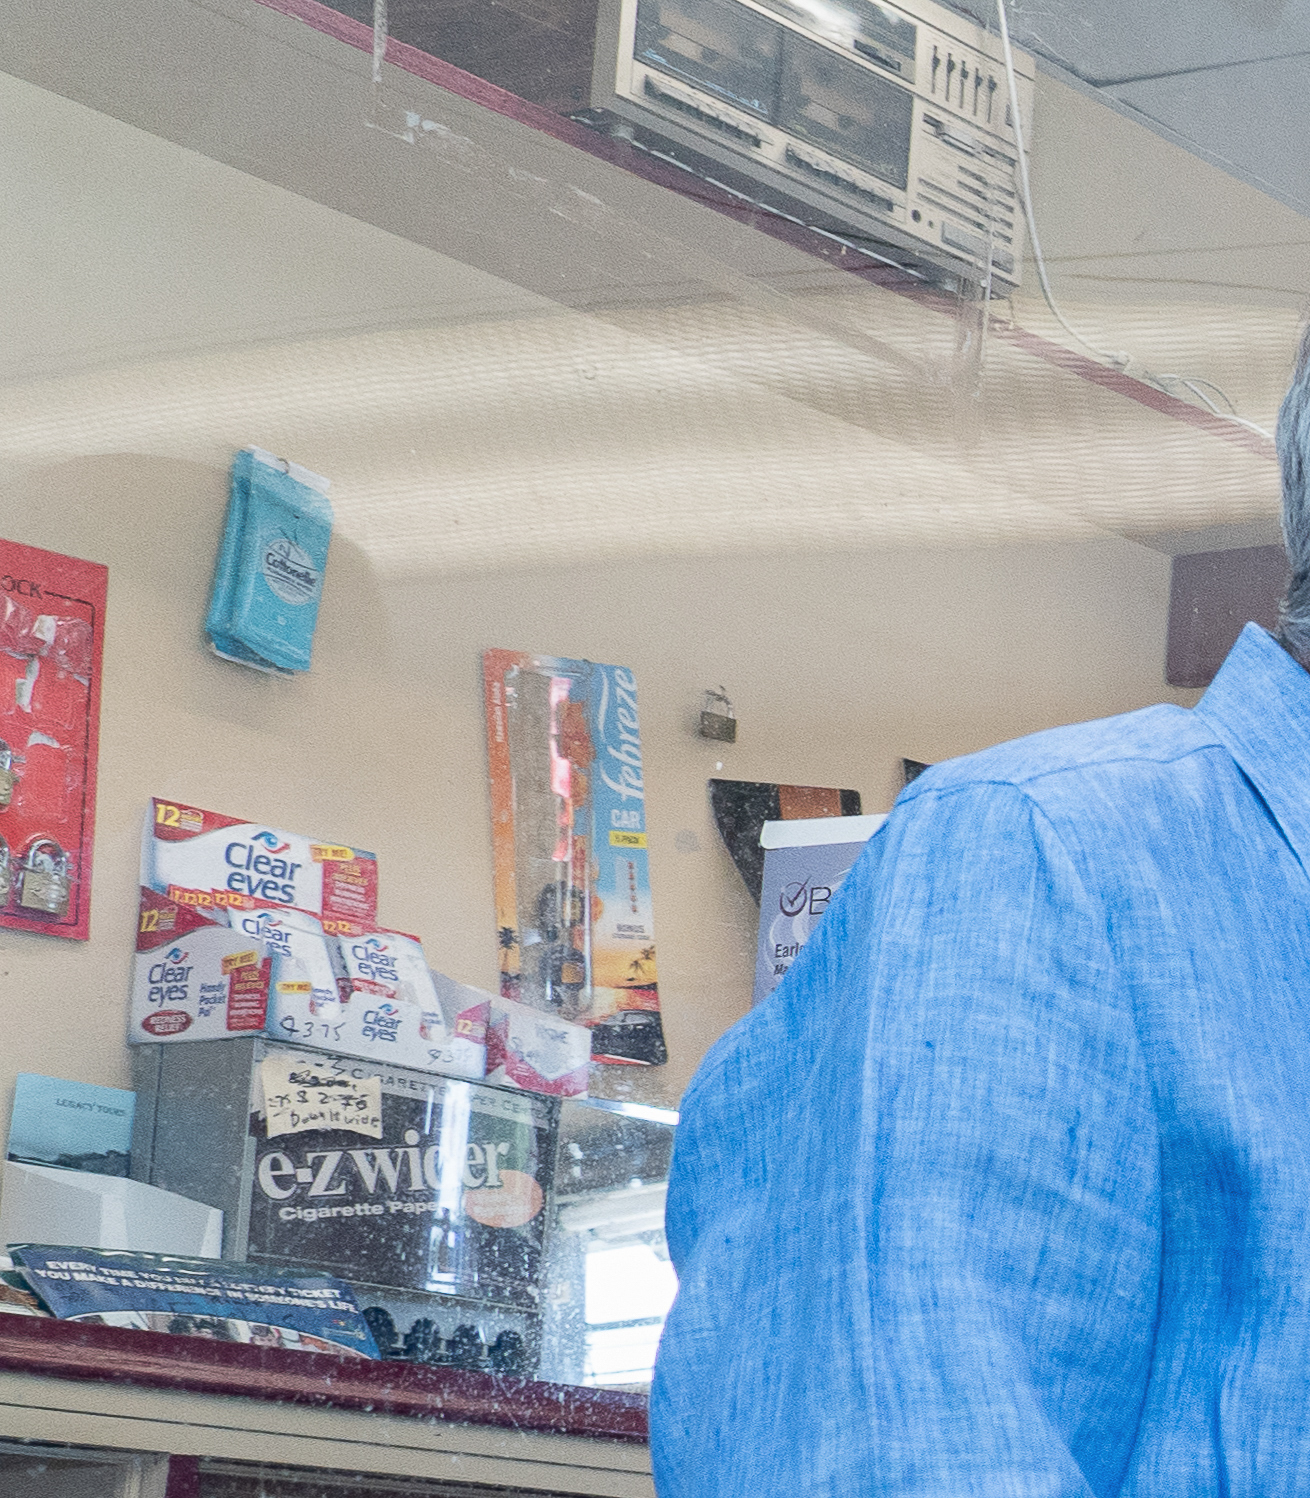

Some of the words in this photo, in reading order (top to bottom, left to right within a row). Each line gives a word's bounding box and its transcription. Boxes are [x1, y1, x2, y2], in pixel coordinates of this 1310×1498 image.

[601, 669, 643, 800] febreze
[157, 804, 180, 827] 12
[610, 809, 641, 829] CAR
[225, 842, 302, 881] Clear
[227, 870, 296, 904] eyes
[141, 910, 158, 933] 12
[242, 918, 292, 943] Clear
[352, 945, 398, 967] Clear
[774, 943, 804, 958] Earl
[148, 963, 193, 984] Clear
[358, 962, 399, 982] eyes
[148, 984, 188, 1008] eyes
[363, 1010, 402, 1030] Clear
[456, 1018, 474, 1034] 12
[362, 1025, 398, 1042] eyes
[279, 1201, 384, 1222] Cigarette
[35, 1269, 71, 1281] YOU
[73, 1272, 120, 1286] MAKE
[46, 1261, 97, 1272] EVERY
[99, 1267, 139, 1279] TIME
[287, 1288, 342, 1298] TICKET
